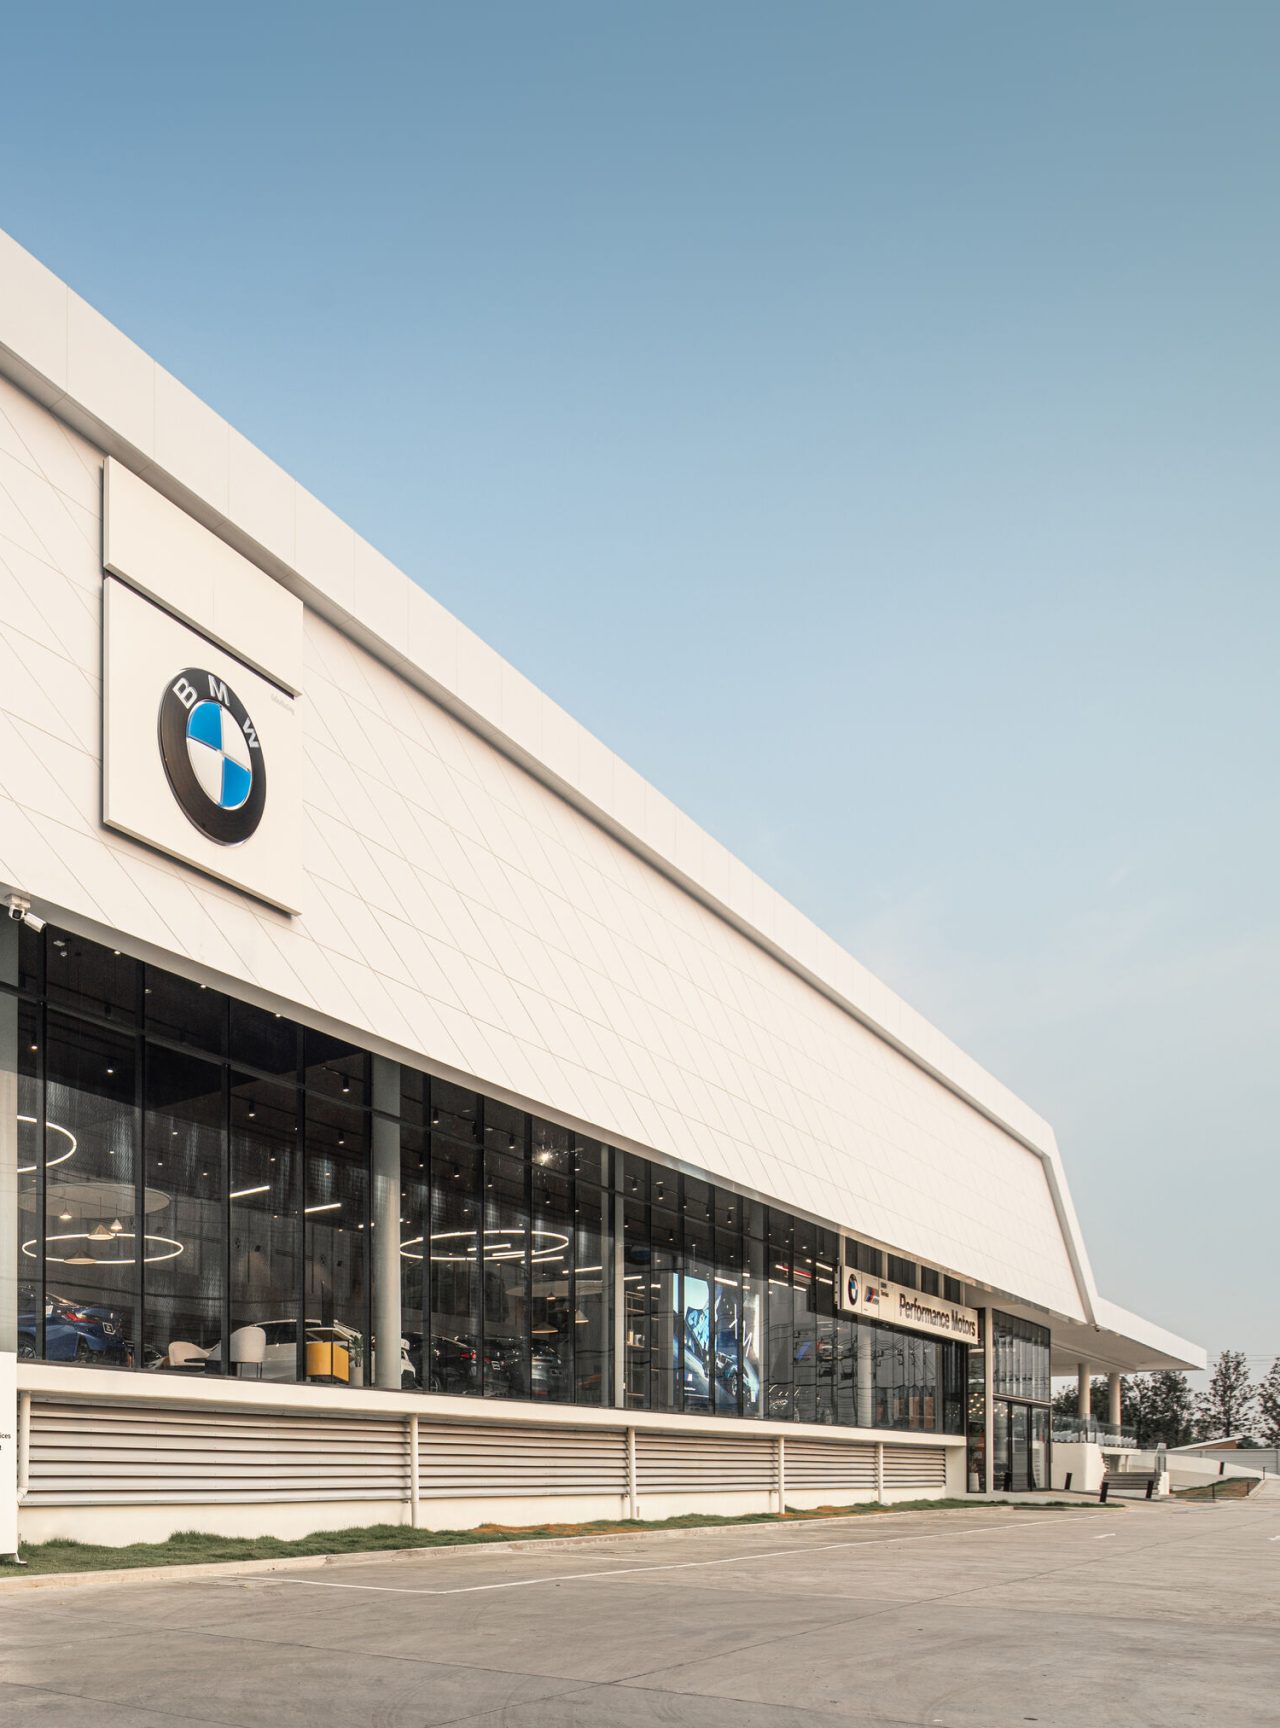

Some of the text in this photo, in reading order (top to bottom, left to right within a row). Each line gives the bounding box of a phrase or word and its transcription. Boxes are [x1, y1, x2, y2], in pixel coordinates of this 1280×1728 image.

[172, 674, 260, 748] BMW
[899, 1293, 976, 1337] Performance Motors
